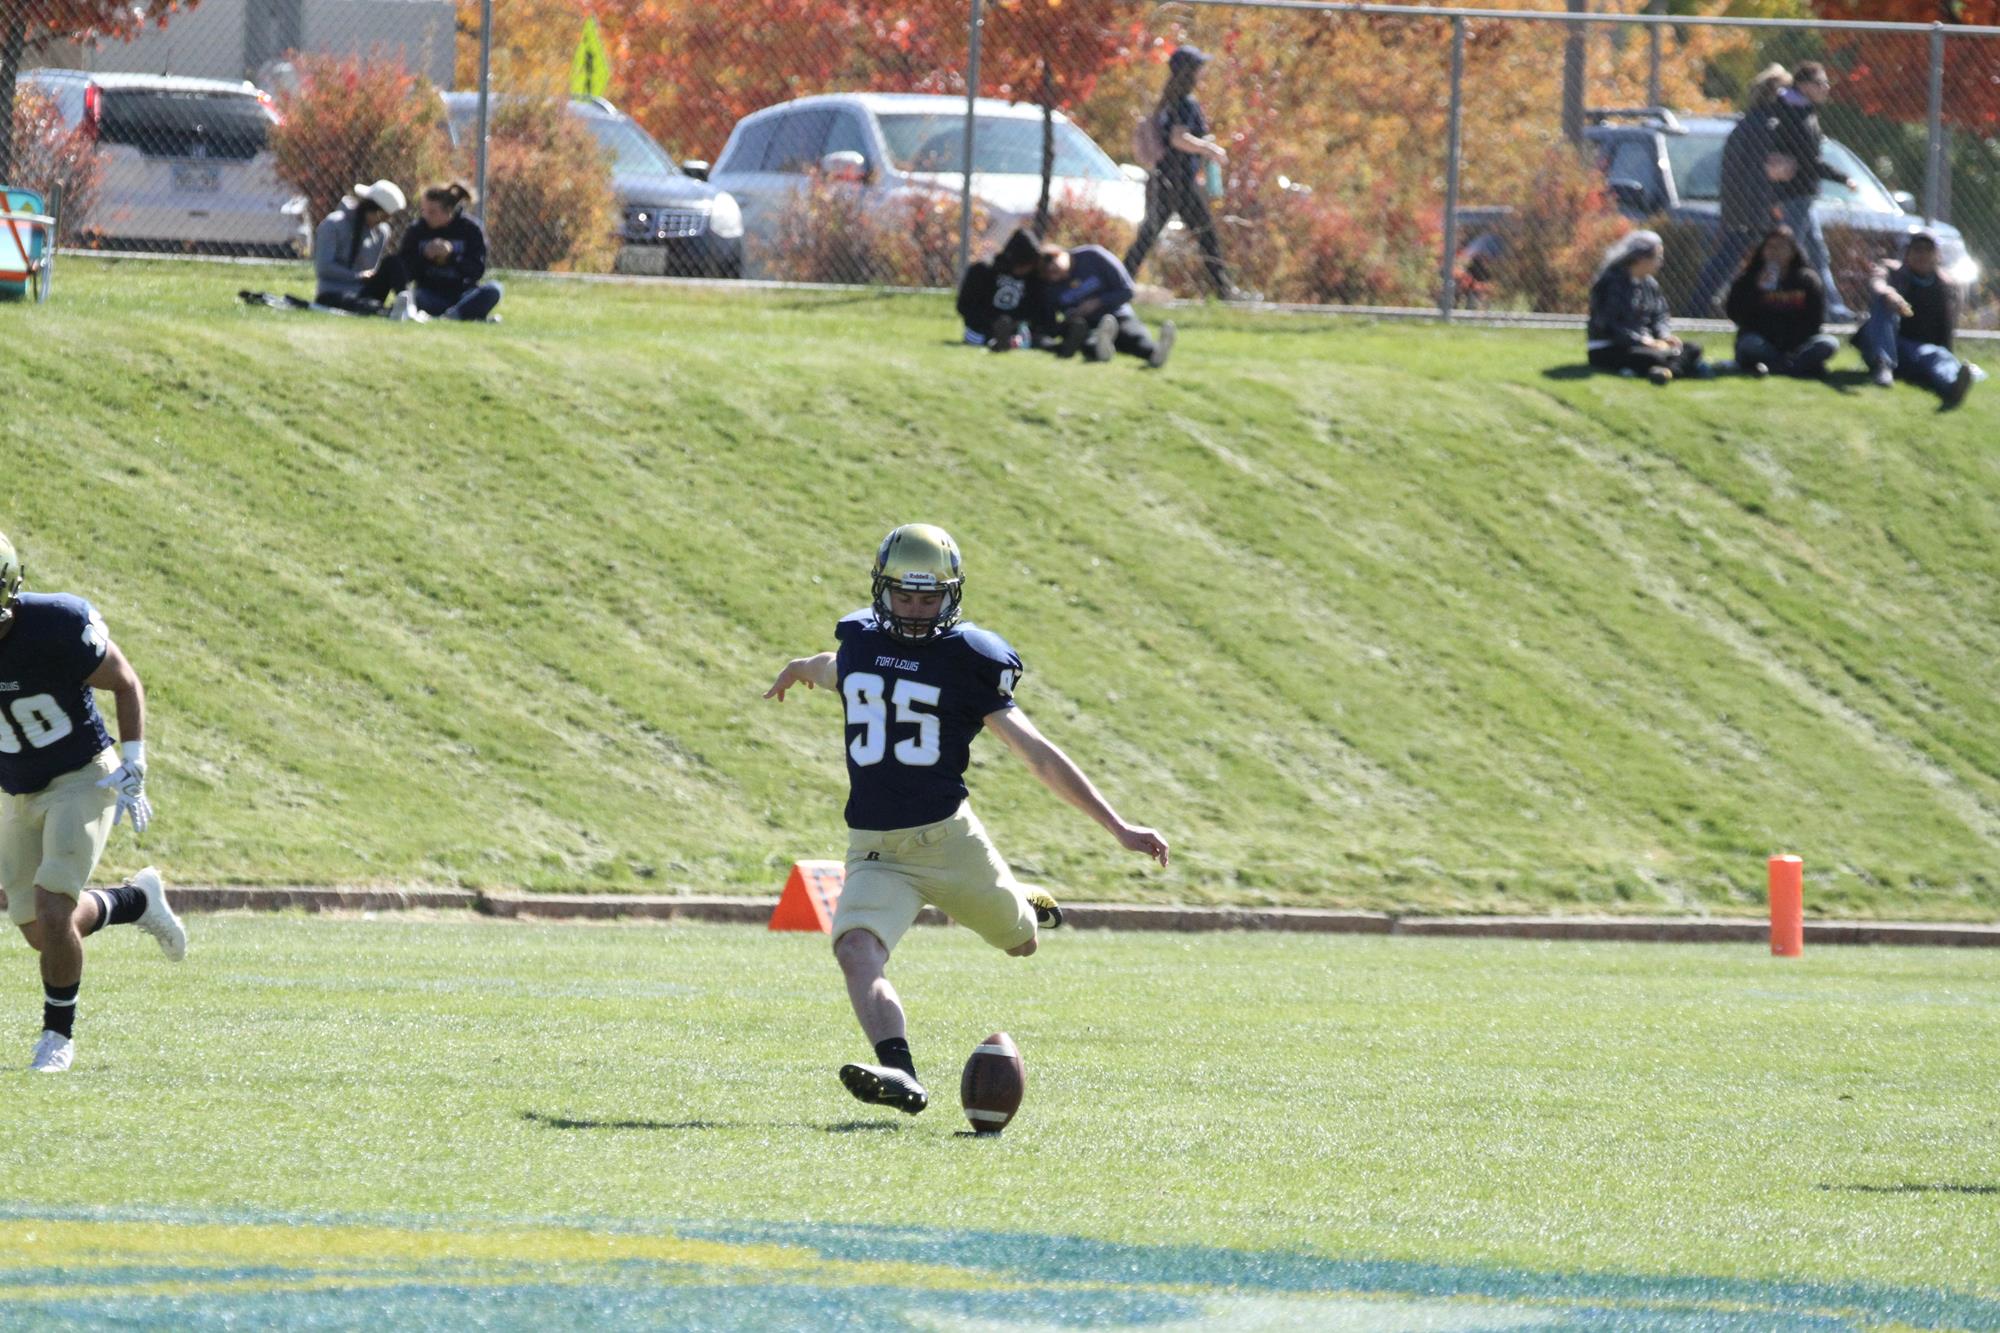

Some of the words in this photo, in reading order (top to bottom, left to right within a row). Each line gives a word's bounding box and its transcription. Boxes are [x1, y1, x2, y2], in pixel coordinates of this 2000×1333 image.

[875, 656, 895, 667] FORT
[895, 659, 919, 671] LEWIS
[843, 672, 941, 766] 95
